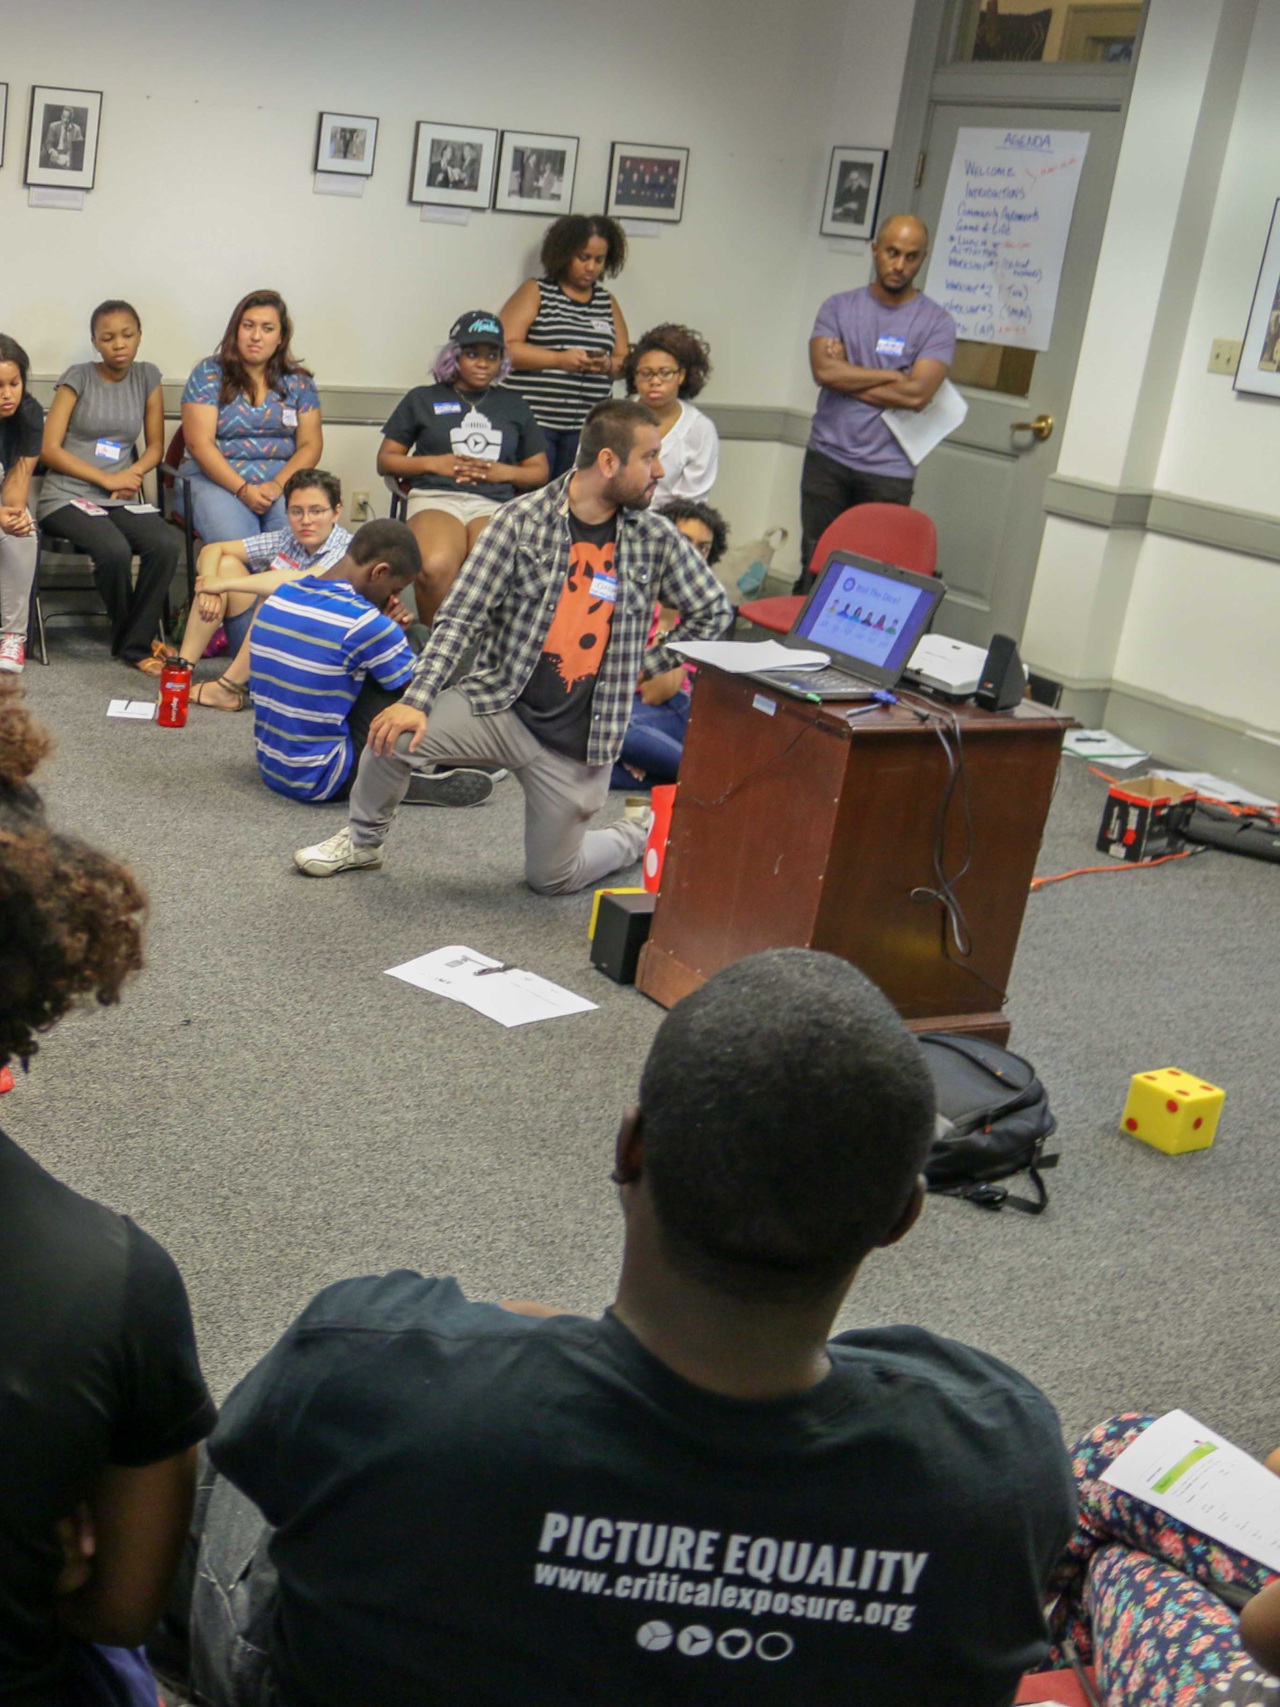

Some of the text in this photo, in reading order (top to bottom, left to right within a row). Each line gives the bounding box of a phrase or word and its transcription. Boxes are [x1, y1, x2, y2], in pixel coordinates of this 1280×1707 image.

[1003, 132, 1051, 148] AGENDA
[965, 160, 1016, 177] WELCOME
[538, 1512, 929, 1595] PICTURE EQUALITY
[534, 1562, 917, 1632] www.criticalexposure.org
